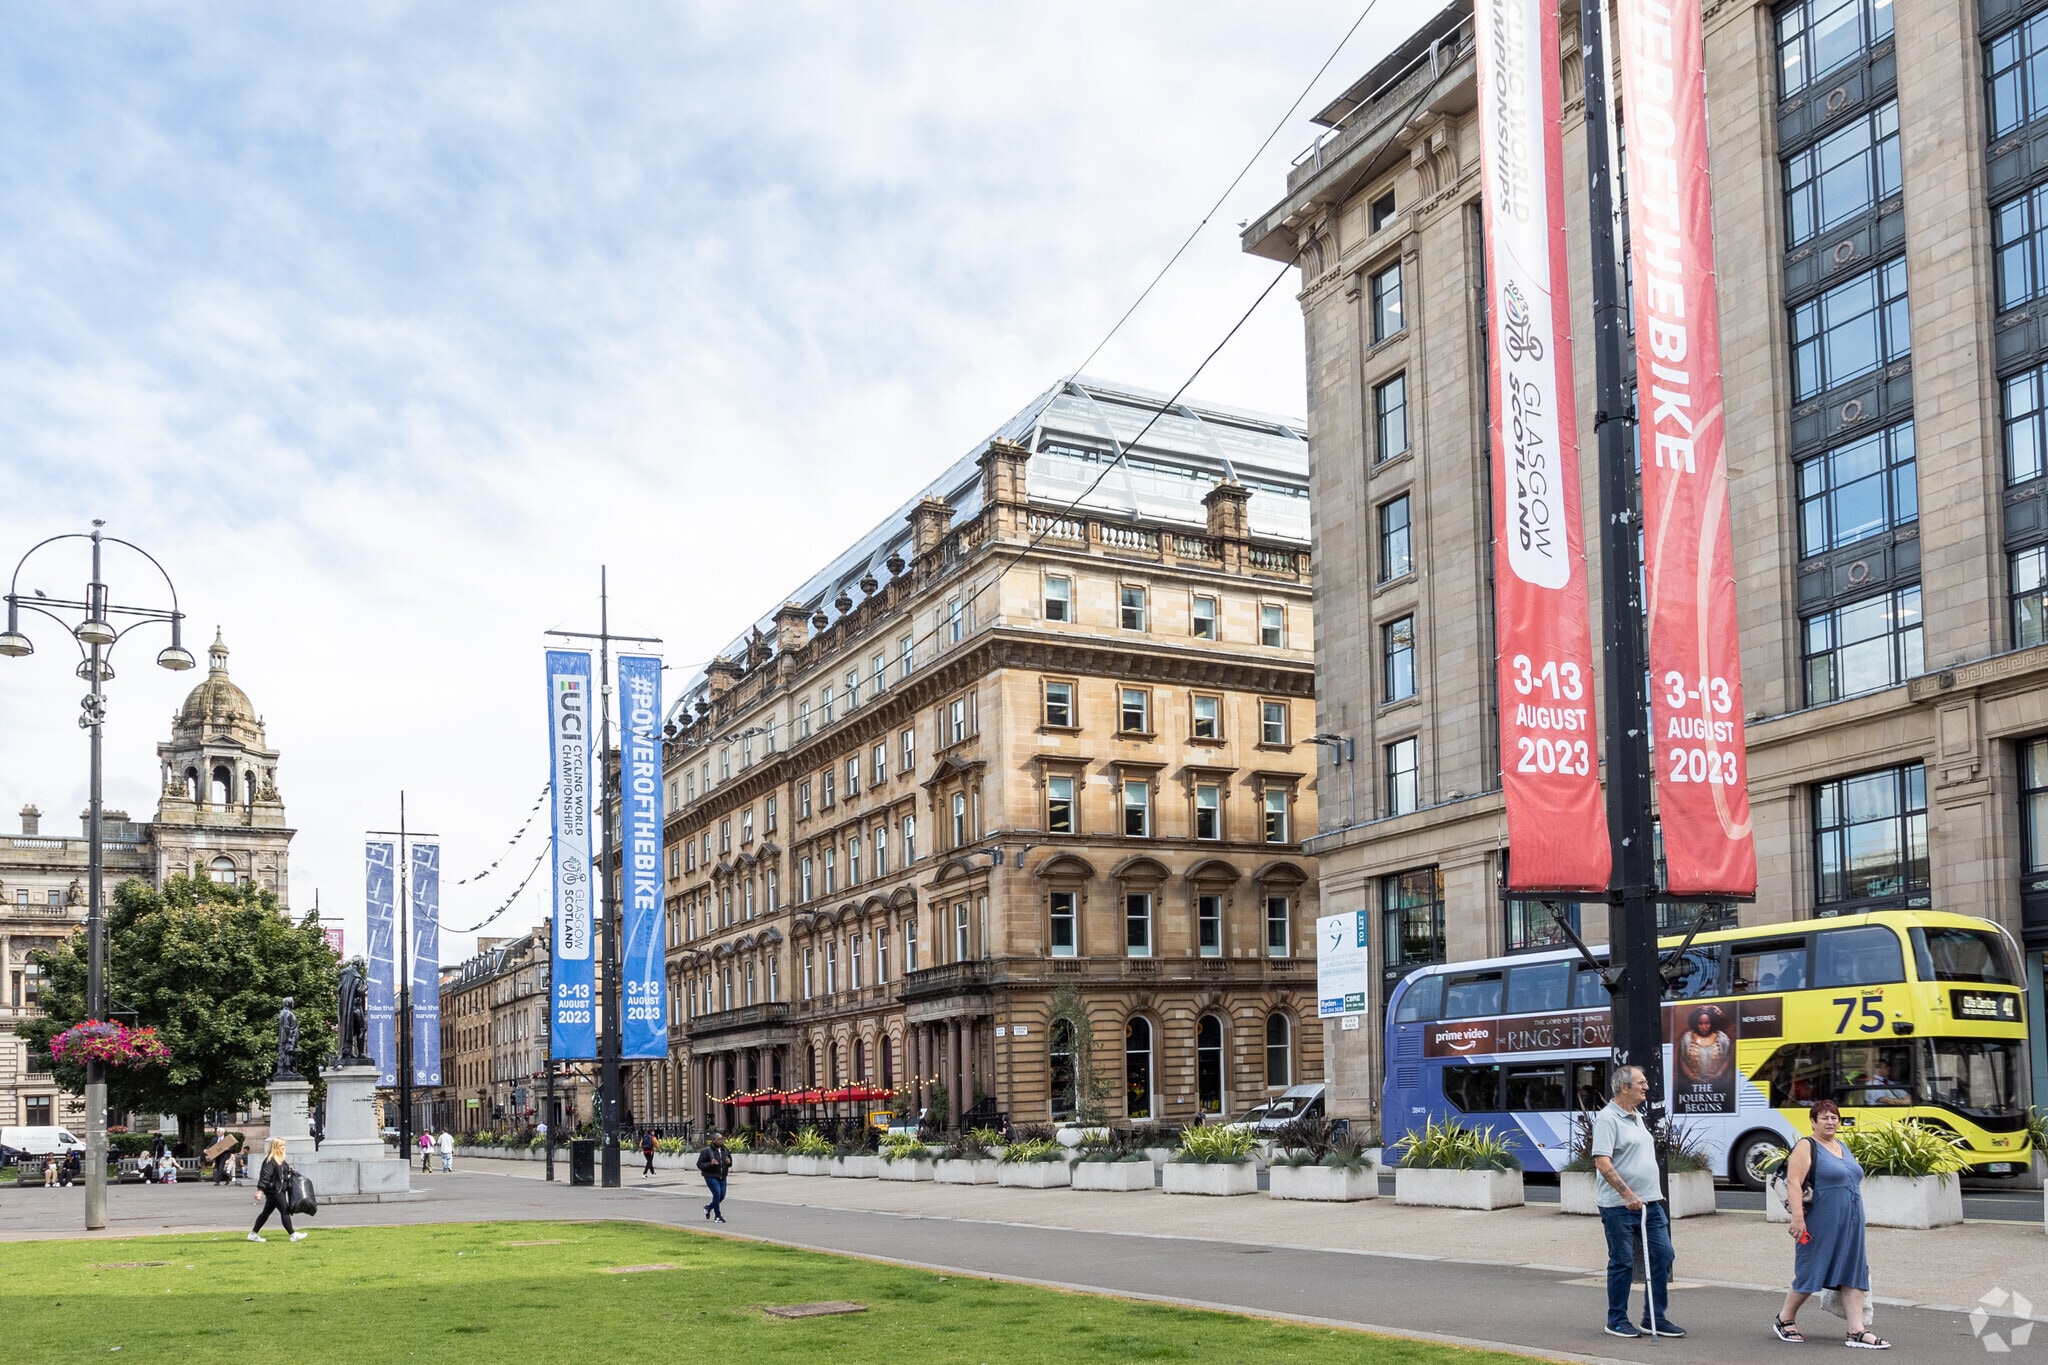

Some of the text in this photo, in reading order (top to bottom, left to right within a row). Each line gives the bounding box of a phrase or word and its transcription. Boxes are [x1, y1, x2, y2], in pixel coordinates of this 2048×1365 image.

[1506, 0, 1529, 224] CLING WORLD
[1508, 279, 1528, 312] 2023
[1508, 371, 1531, 551] SCOTLAND
[1523, 382, 1552, 558] GLASGOW
[1513, 654, 1583, 701] 3-13
[1664, 671, 1732, 713] 3-13
[560, 692, 582, 741] UCI
[1516, 703, 1587, 730] AUGUST
[1667, 717, 1734, 743] AUGUST
[1517, 737, 1590, 776] 2023
[1670, 748, 1737, 785] 2023
[562, 744, 573, 835] CHAMPIONSHIPS
[573, 745, 583, 836] CYCLING WORLD
[630, 675, 655, 910] #POWEROFTHEBIKE
[565, 889, 573, 949] SCOTLAND
[574, 889, 584, 949] GLASGOW
[1359, 931, 1364, 943] TO
[558, 984, 590, 998] 3-13
[627, 981, 659, 995] 3-13
[627, 996, 660, 1005] AUGUST
[1346, 994, 1360, 1002] CBRE
[558, 1000, 590, 1009] AUGUST
[558, 1010, 590, 1023] 2023
[627, 1007, 660, 1020] 2023
[1321, 1000, 1337, 1008] Ryden
[1833, 996, 1885, 1034] 75
[1742, 1014, 1776, 1023] NEW SERIES
[1435, 1028, 1489, 1044] prime video
[1508, 1028, 1561, 1050] RINGS
[1572, 1025, 1611, 1045] POW
[1678, 1093, 1726, 1104] JOURNEY
[1691, 1083, 1713, 1093] THE
[1685, 1103, 1722, 1112] BEGINS
